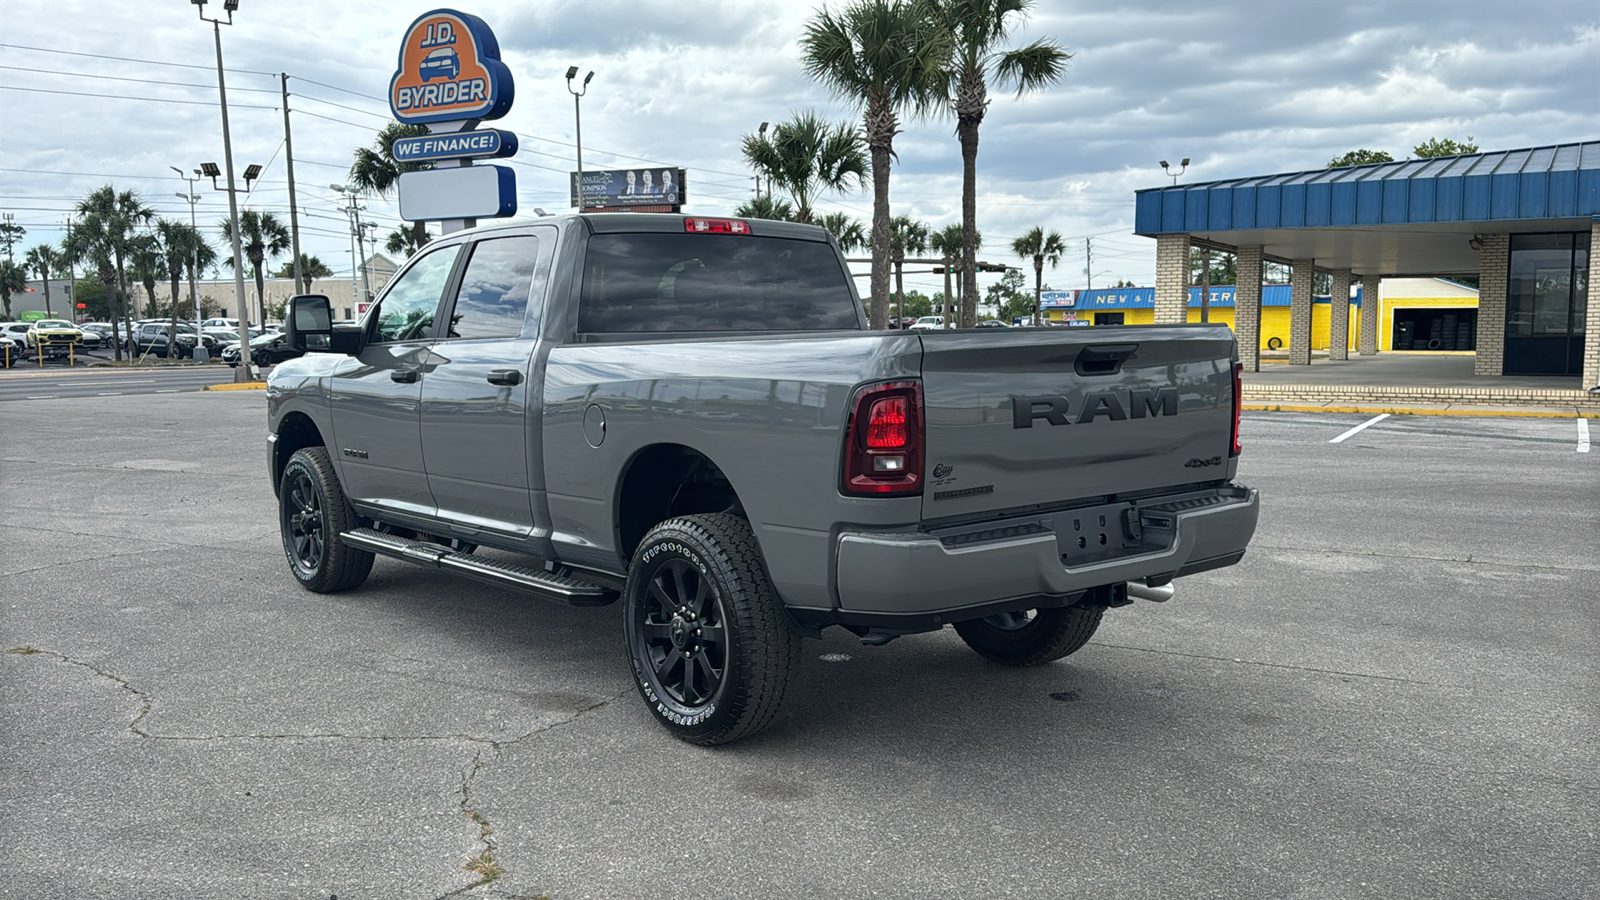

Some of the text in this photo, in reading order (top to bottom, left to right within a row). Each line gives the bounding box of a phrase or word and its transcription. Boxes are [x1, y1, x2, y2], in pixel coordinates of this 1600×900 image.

[420, 22, 456, 47] J.D.
[397, 79, 487, 109] BYRIDER
[398, 135, 494, 155] WE FINANCE!
[575, 184, 607, 192] TOMPSON
[1096, 295, 1128, 304] NEW
[1012, 387, 1178, 429] RAM
[933, 463, 954, 479] Bay
[642, 542, 707, 574] Firestone
[656, 702, 716, 726] TRANSFORCE
